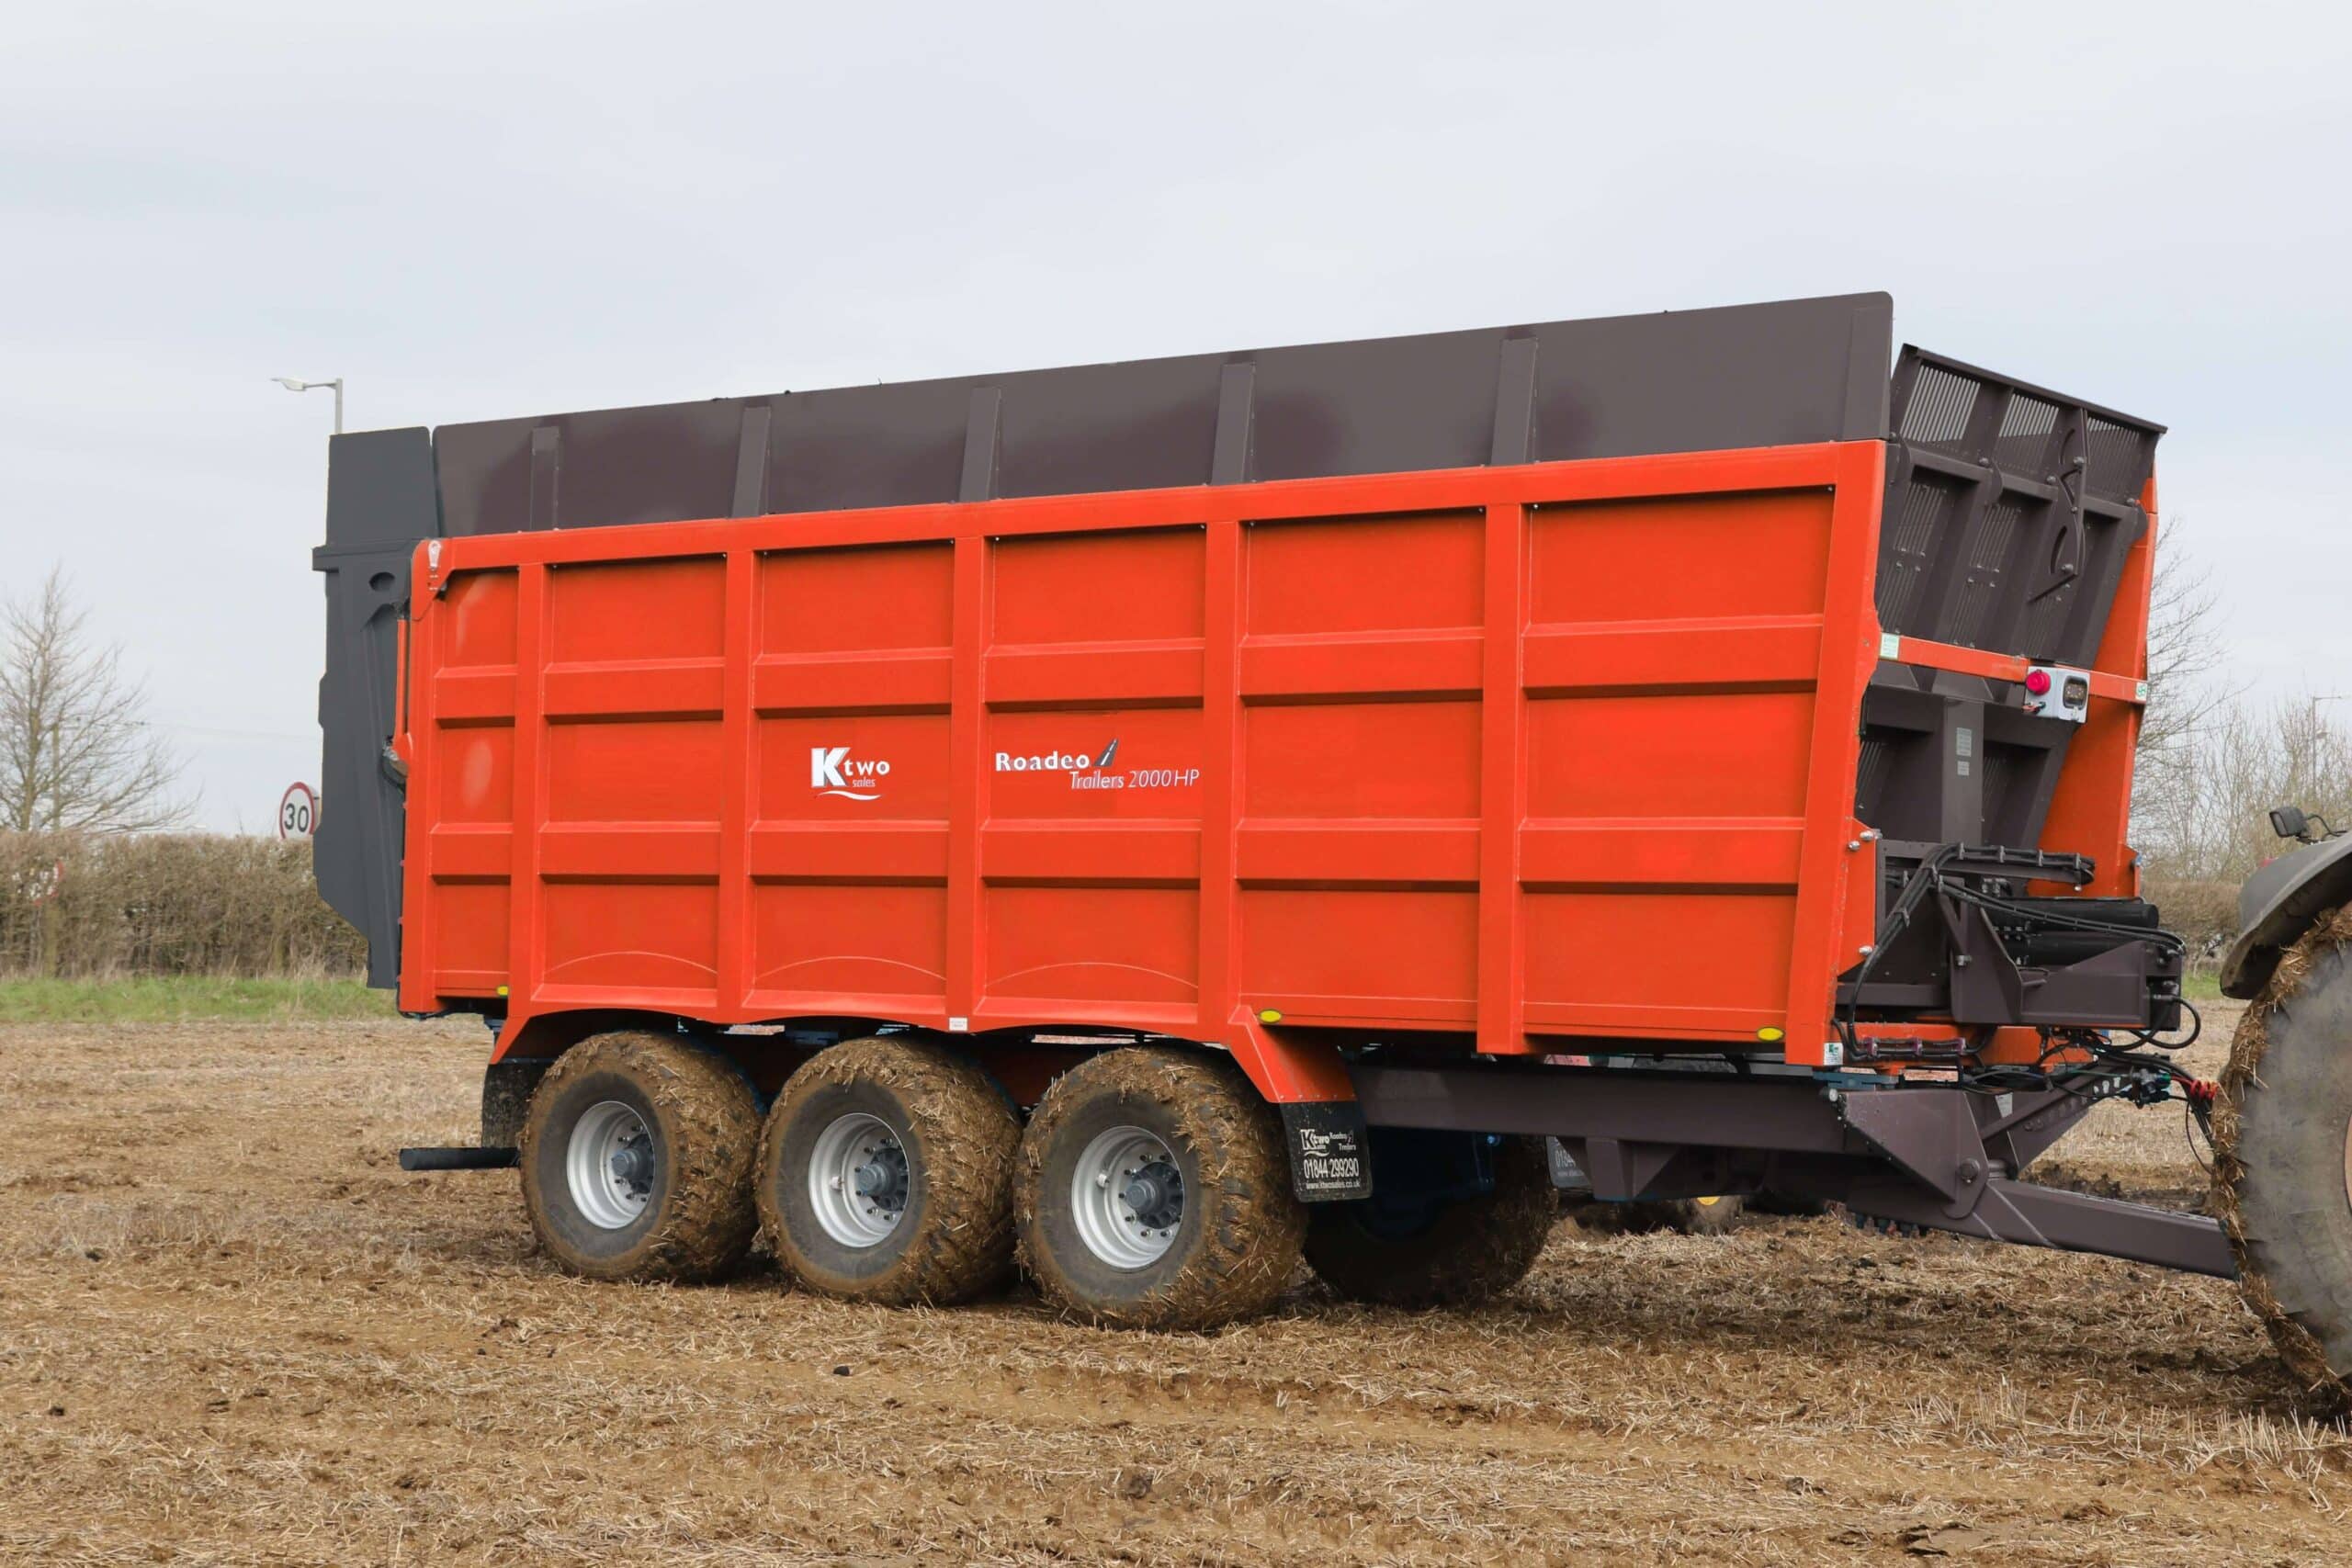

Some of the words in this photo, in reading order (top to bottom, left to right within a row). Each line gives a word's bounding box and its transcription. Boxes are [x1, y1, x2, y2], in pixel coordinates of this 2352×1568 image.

[995, 750, 1090, 772] Roadeo
[852, 777, 876, 788] sales
[1069, 770, 1125, 790] Trailers
[284, 803, 310, 832] 30
[1304, 1158, 1329, 1179] 01844
[1329, 1157, 1360, 1178] 299290
